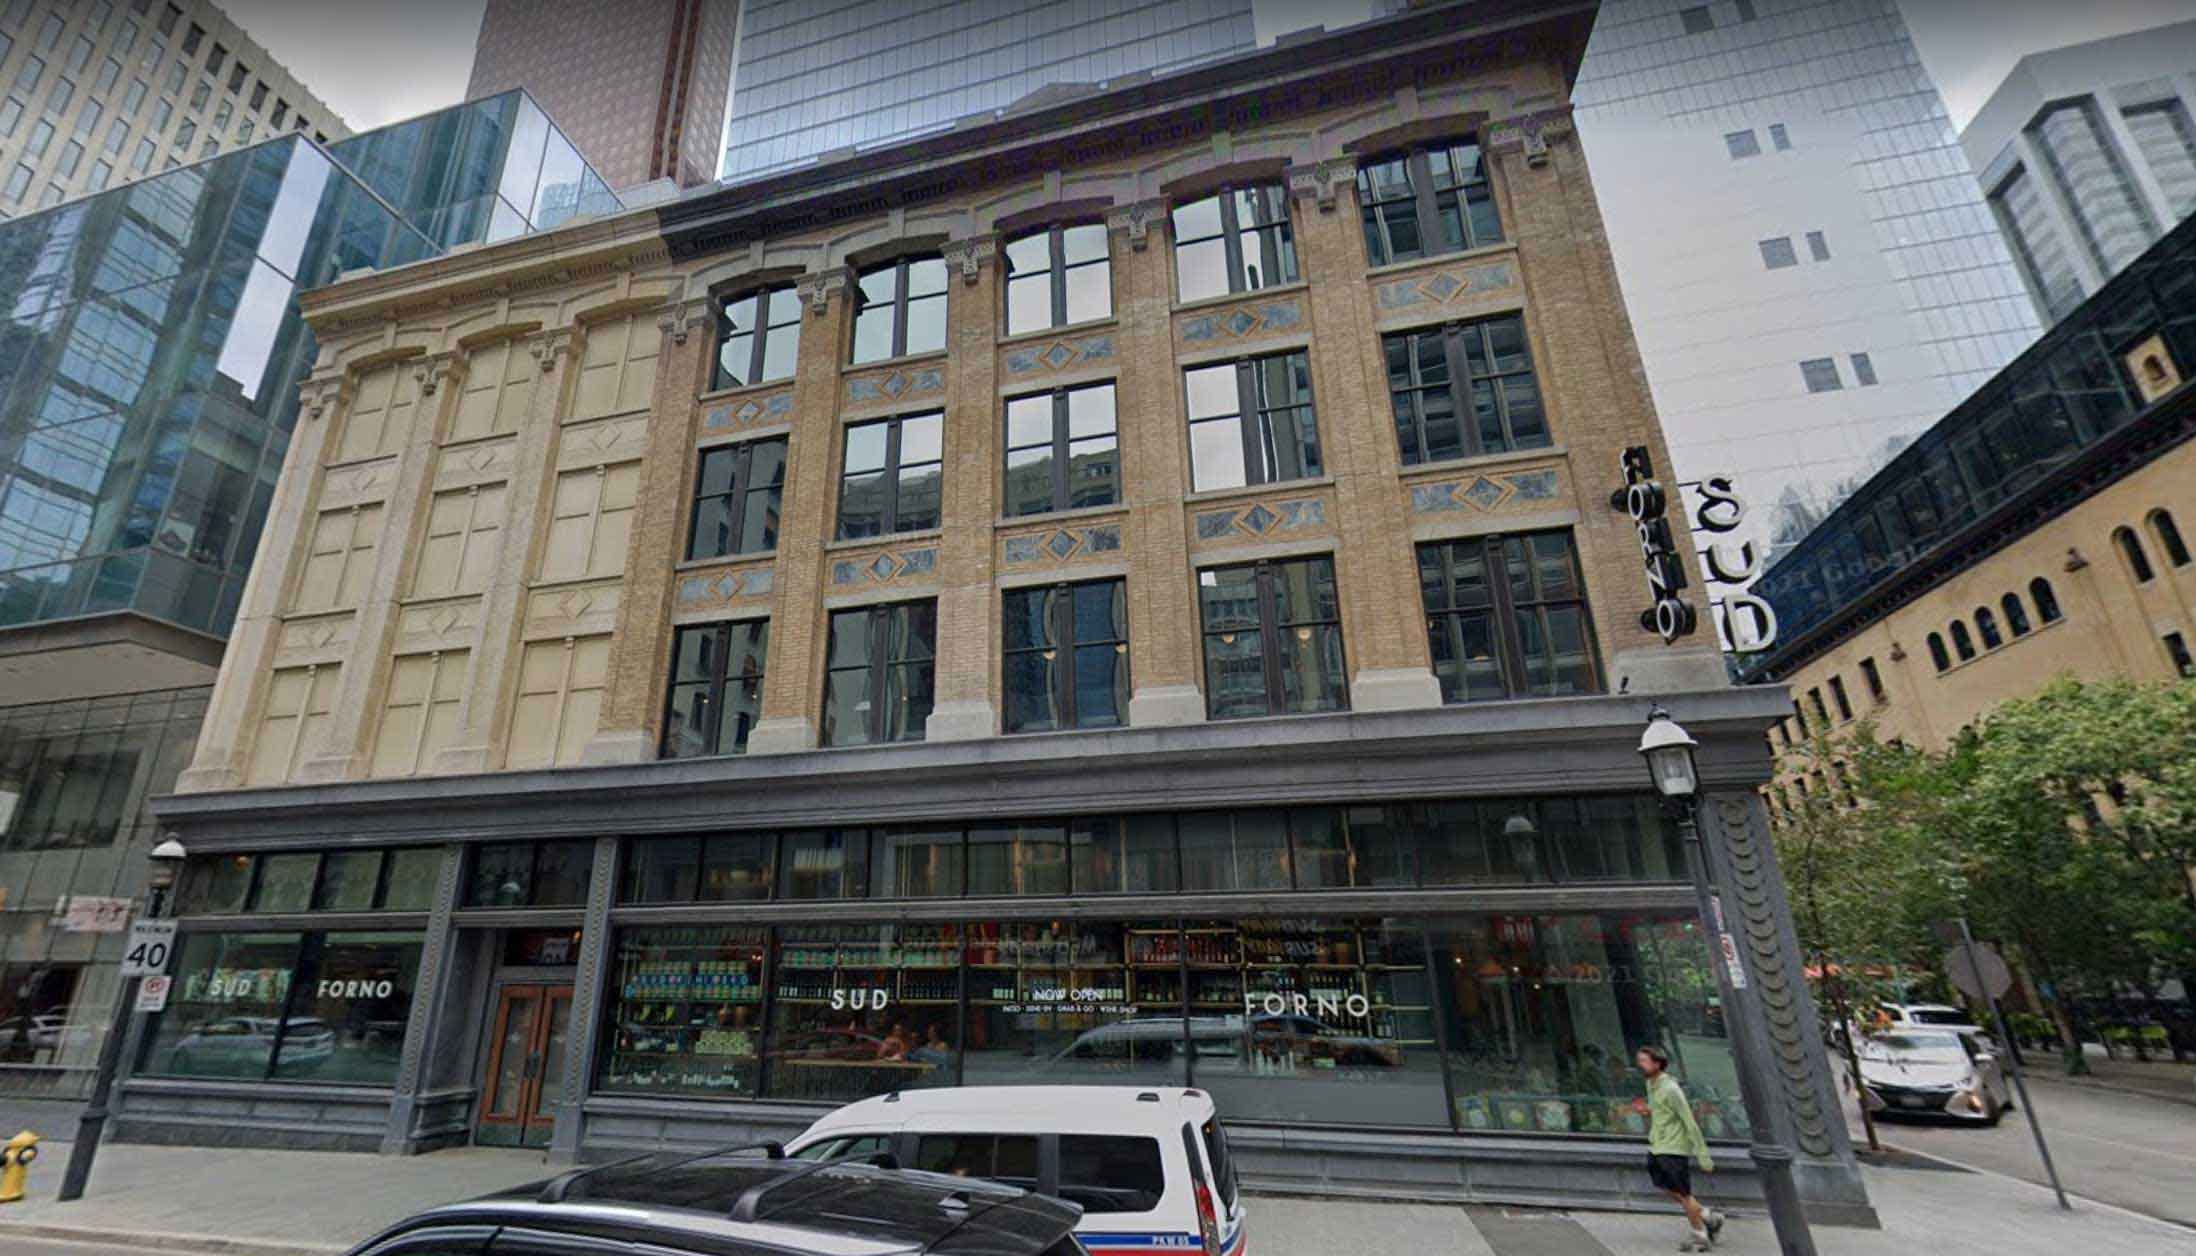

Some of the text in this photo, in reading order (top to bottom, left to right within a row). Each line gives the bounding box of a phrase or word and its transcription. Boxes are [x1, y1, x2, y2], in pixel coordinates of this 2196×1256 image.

[1697, 473, 1777, 653] SUD
[127, 943, 167, 968] 40
[209, 979, 394, 999] SUD FORNO
[831, 988, 889, 1010] SUD
[1032, 988, 1104, 1001] NOW OPEN
[1244, 992, 1369, 1017] FORNO
